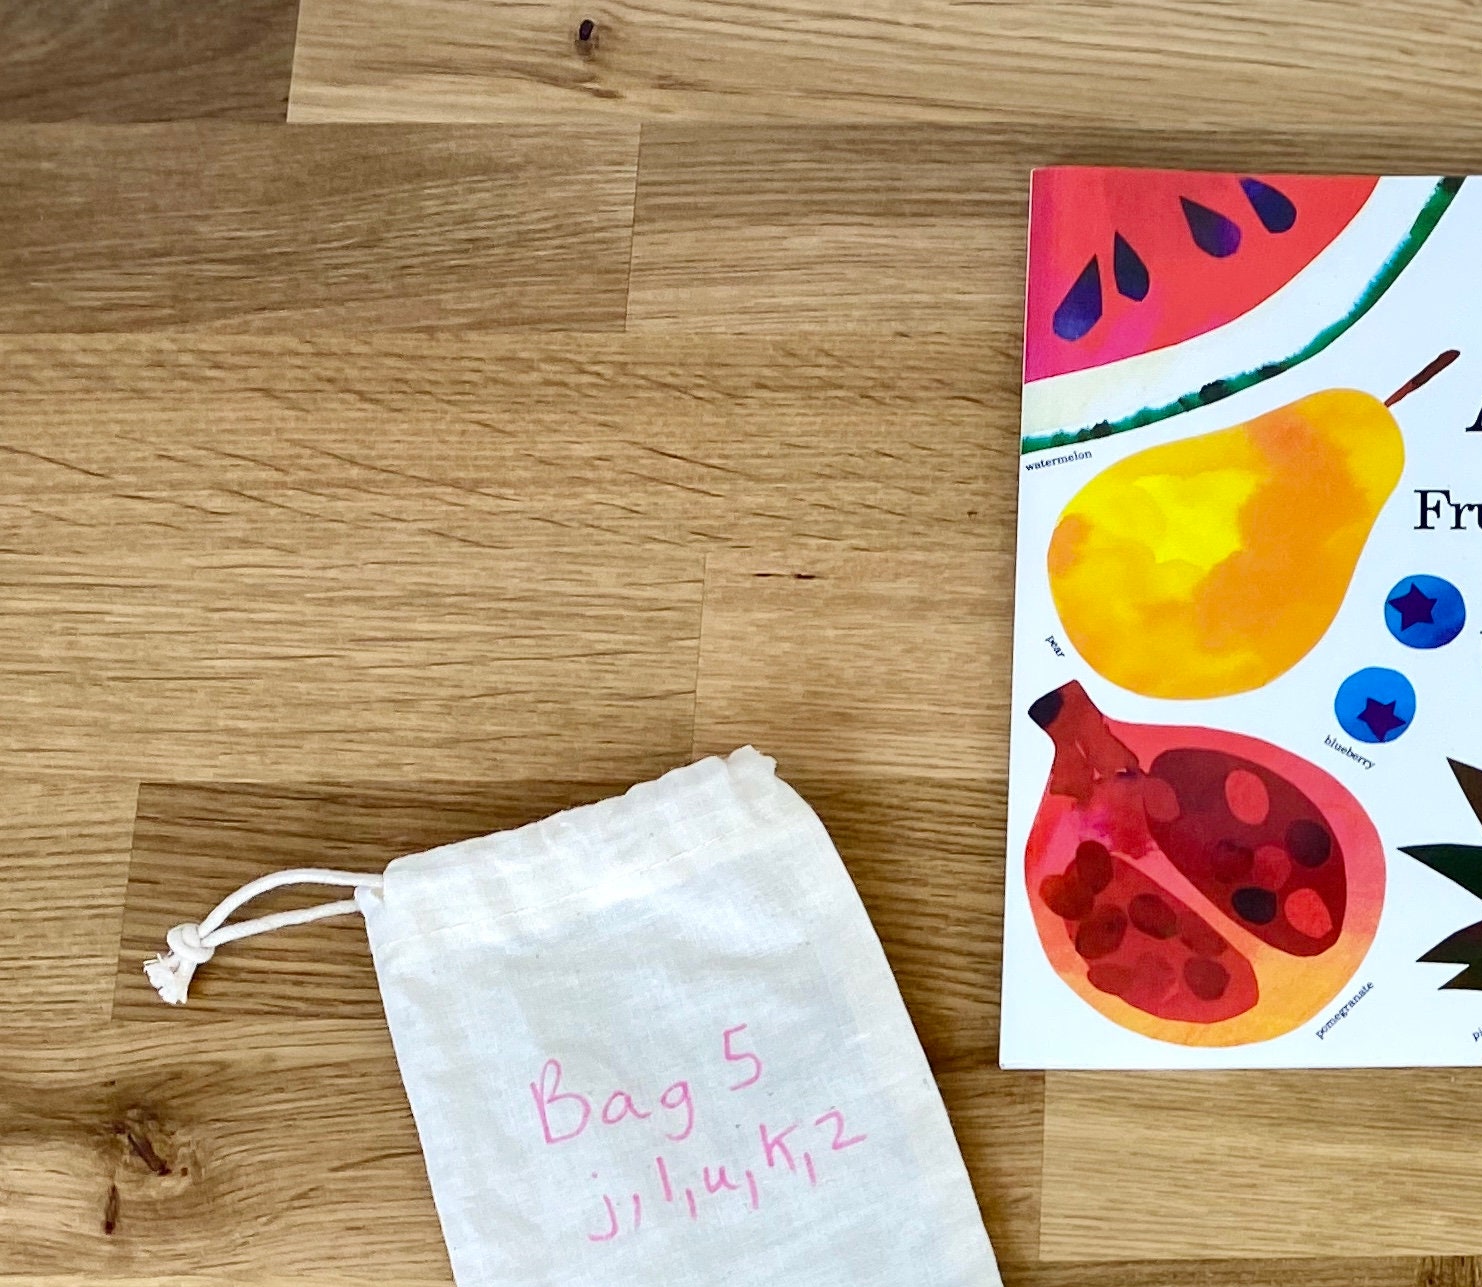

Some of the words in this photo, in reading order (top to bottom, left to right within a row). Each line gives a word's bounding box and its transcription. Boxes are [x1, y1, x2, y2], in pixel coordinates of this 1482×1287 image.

[1024, 449, 1094, 473] watermelon
[1044, 633, 1067, 659] pear
[1323, 734, 1376, 770] blueberry
[1315, 980, 1375, 1040] pomegranate
[530, 1059, 695, 1145] Bag
[722, 1023, 764, 1091] 5
